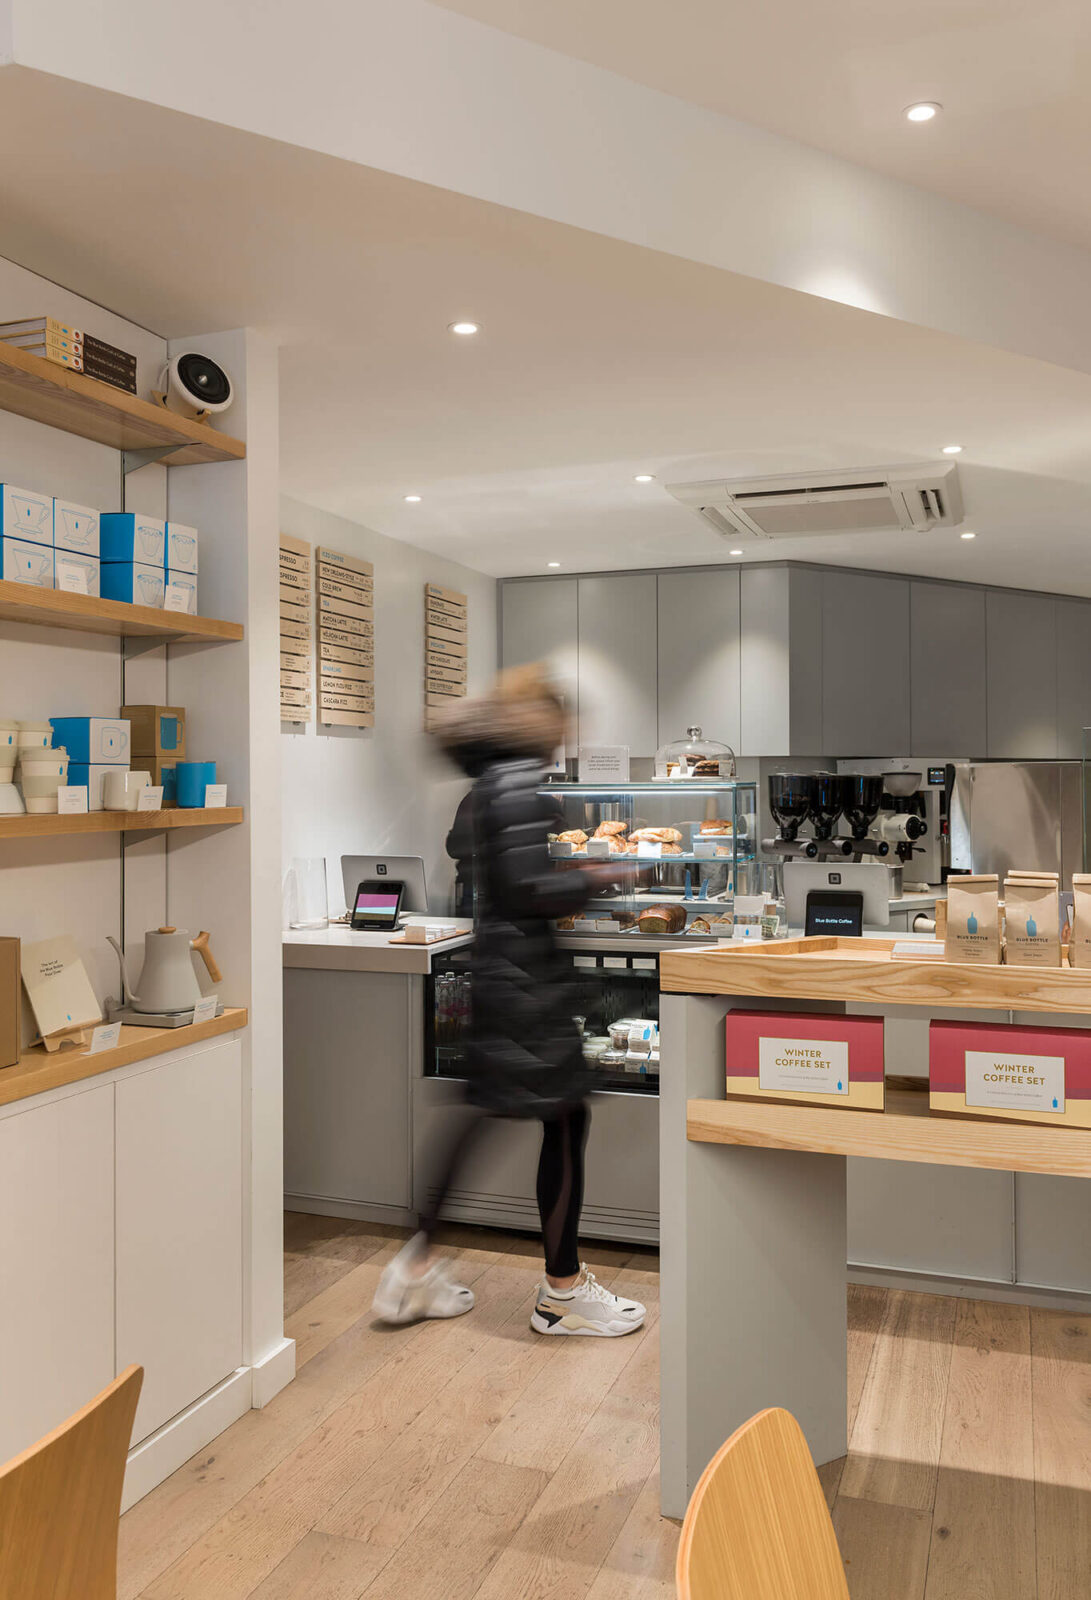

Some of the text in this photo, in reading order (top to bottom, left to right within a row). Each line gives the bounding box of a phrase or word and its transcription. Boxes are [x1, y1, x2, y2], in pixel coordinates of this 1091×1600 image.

[280, 554, 296, 564] SPRESSO
[280, 572, 297, 582] SPRESSO
[785, 1049, 821, 1058] WINTER
[776, 1059, 831, 1069] COFFEE SET
[994, 1064, 1035, 1073] WINTER
[984, 1074, 1045, 1085] COFFEE SET
